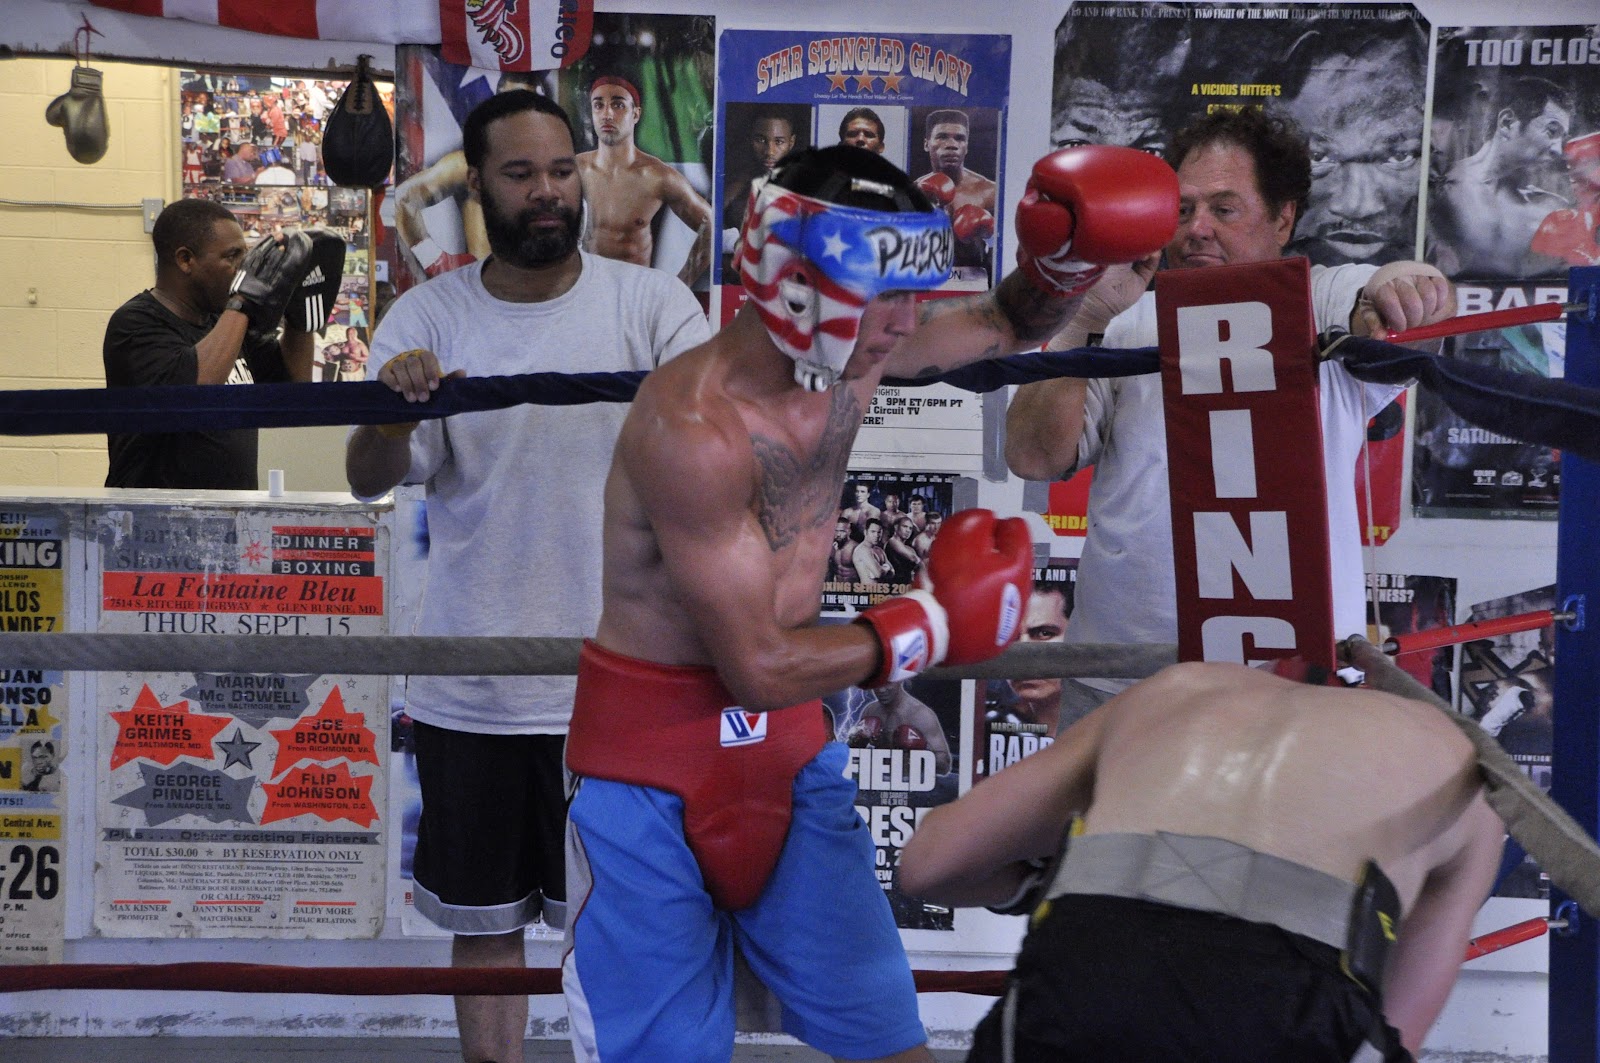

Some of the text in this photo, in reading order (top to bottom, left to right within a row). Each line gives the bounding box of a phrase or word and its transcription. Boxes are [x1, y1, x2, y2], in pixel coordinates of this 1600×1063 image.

[1213, 9, 1235, 19] FIGHT
[1236, 9, 1246, 19] OF
[1247, 9, 1262, 19] THE
[1263, 9, 1289, 20] MONTH
[1464, 39, 1523, 67] TOO
[757, 37, 972, 97] STAR SPANGLED GLORY
[1191, 83, 1282, 96] A VICIOUS HITTER'S
[886, 398, 963, 408] 9PM ET/6PM PT
[873, 406, 904, 415] Circuit
[907, 407, 920, 415] TV
[1177, 301, 1297, 667] RING
[280, 536, 359, 550] DINNER
[281, 561, 361, 575] BOXING
[1045, 568, 1066, 582] AND
[132, 576, 356, 603] La Fontaine Bleu
[853, 582, 890, 594] SERIES
[146, 600, 195, 610] RITCHIE
[276, 603, 308, 612] GLEN
[358, 605, 379, 614] MD.
[138, 612, 351, 636] THUR. SEPT. 15
[215, 675, 285, 689] MARVIN
[200, 689, 301, 704] Mc DOWELL
[134, 713, 184, 727] KEITH
[312, 719, 344, 731] JOE
[125, 727, 192, 741] GRIMES
[295, 732, 360, 745] BROWN
[155, 774, 221, 788] GEORGE
[302, 773, 337, 786] FLIP
[152, 788, 224, 801] PINDELL
[277, 786, 360, 800] JOHNSON
[3, 818, 55, 828] Central Ave.
[232, 832, 295, 843] exciting
[301, 833, 369, 844] Fighters
[123, 846, 362, 860] TOTAL $30.00 BY RESERVATION ONLY
[9, 844, 60, 899] 26
[216, 893, 245, 901] CALL:
[109, 904, 168, 912] MAX KISNER
[293, 907, 323, 915] BALDY
